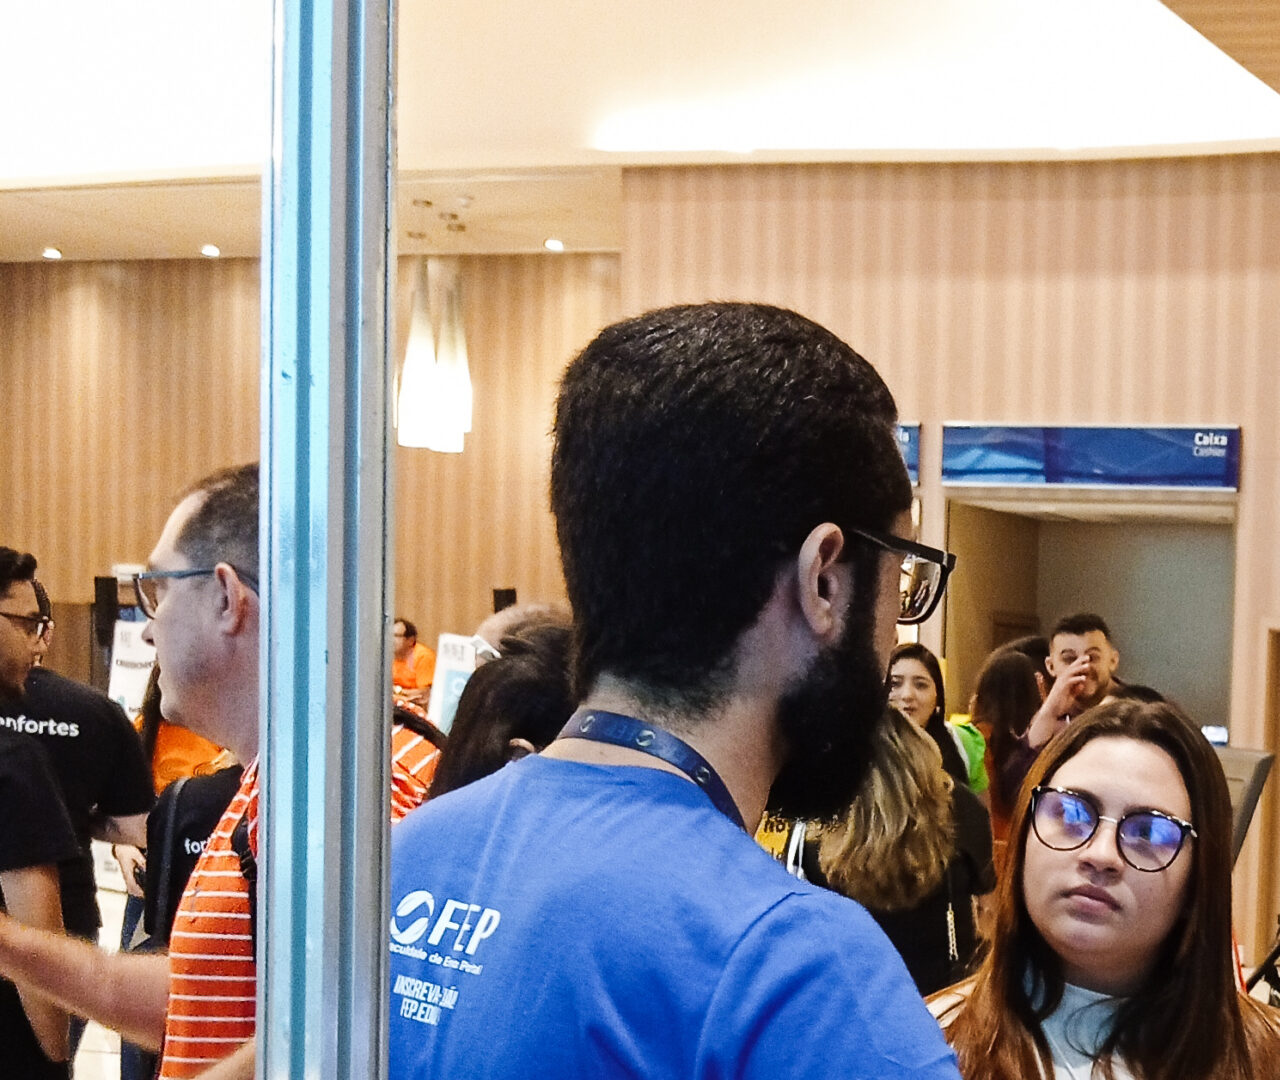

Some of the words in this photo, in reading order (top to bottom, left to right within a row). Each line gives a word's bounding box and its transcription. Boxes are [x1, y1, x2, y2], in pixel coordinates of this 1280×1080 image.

[1194, 432, 1228, 446] Caixa
[184, 837, 208, 855] for
[427, 898, 501, 956] FEP
